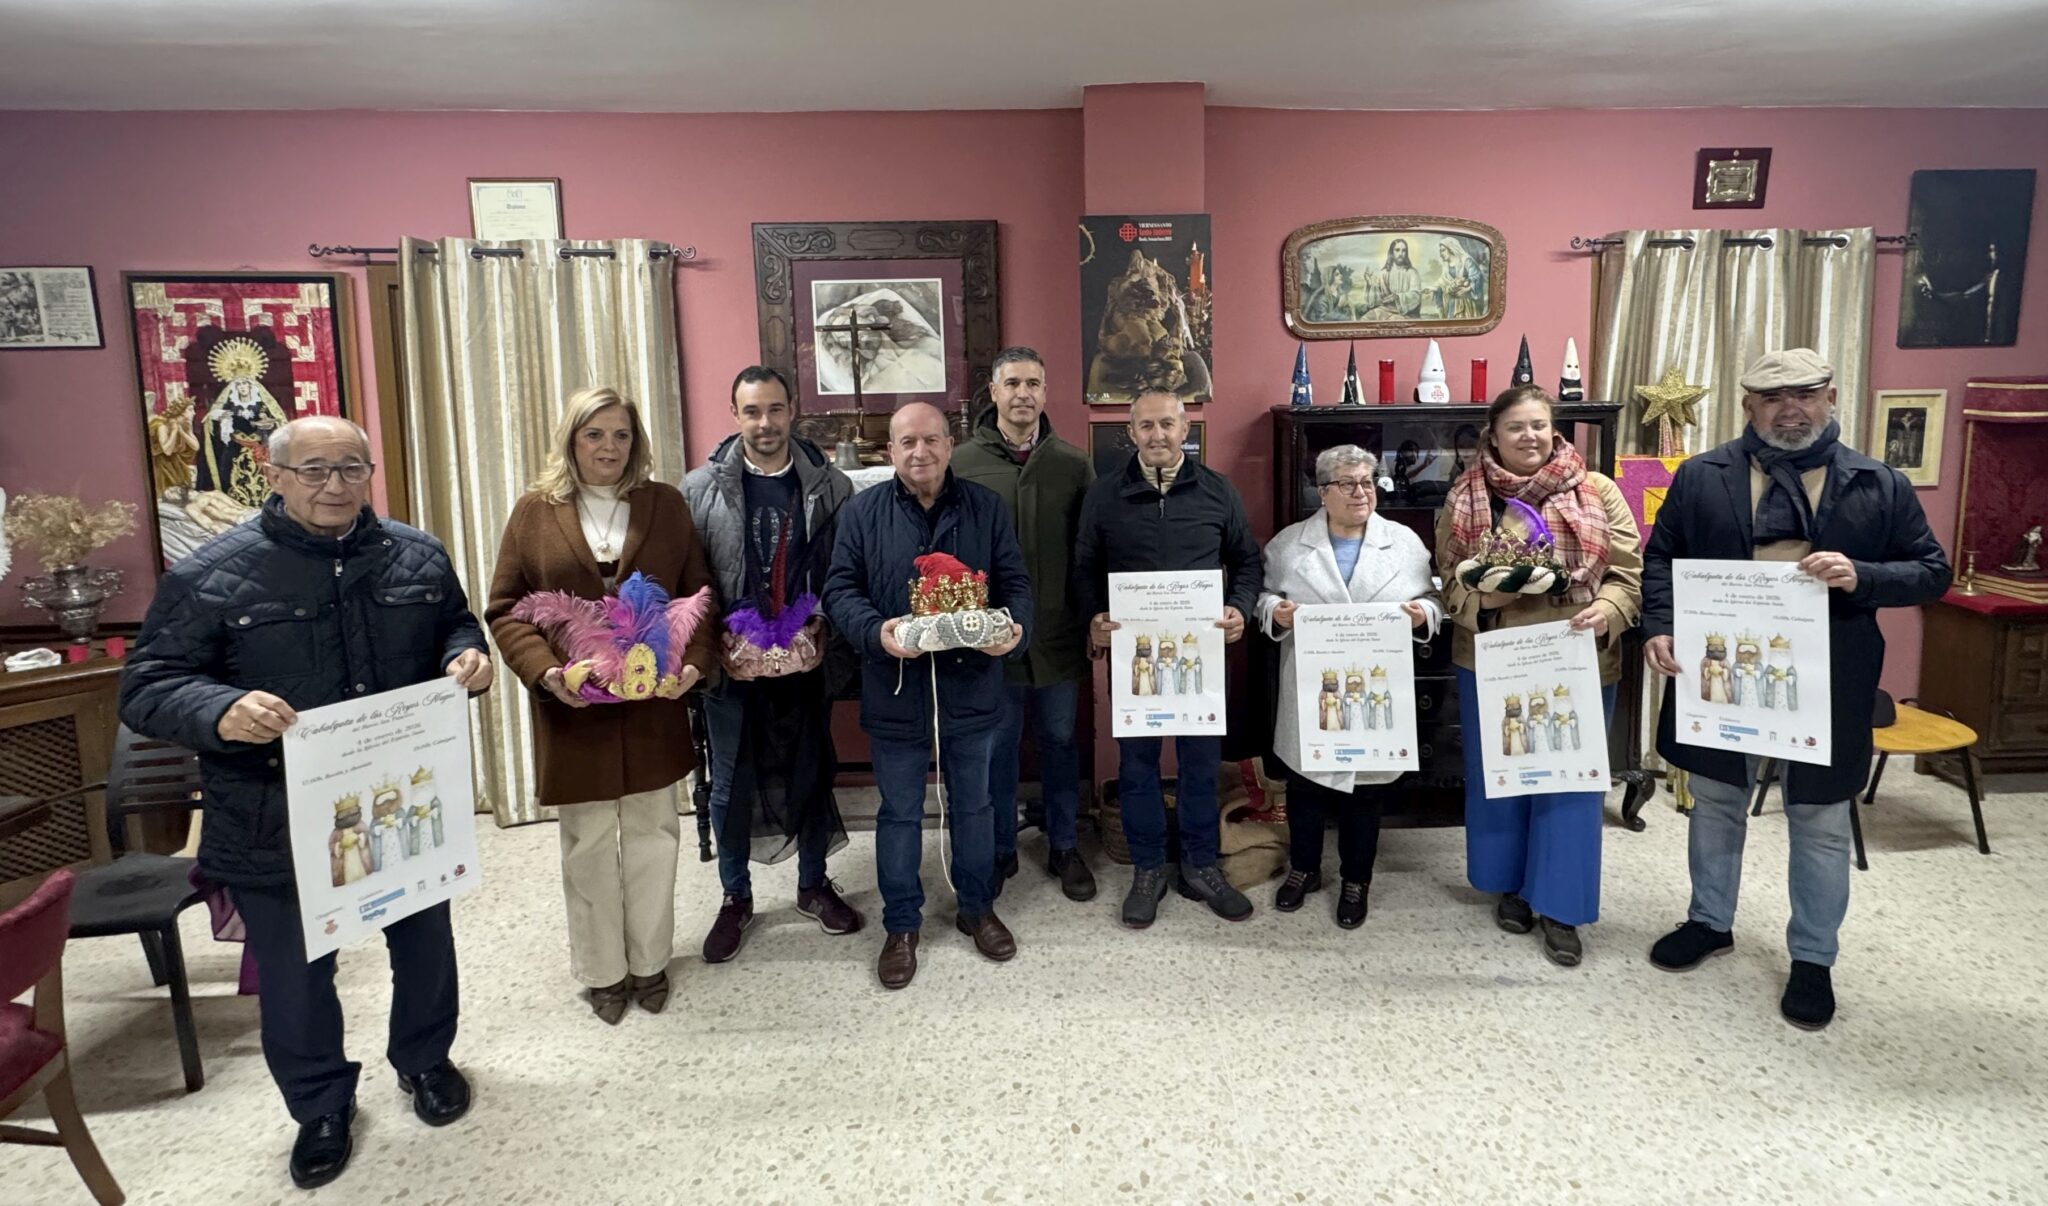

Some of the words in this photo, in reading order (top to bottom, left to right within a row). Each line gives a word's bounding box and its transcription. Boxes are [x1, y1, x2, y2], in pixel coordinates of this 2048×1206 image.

[1748, 572, 1779, 584] Reyes
[1167, 580, 1189, 592] Reyes
[298, 718, 354, 739] Cabalgata
[356, 712, 367, 724] de
[370, 710, 383, 720] los
[385, 701, 420, 718] Reyes
[422, 690, 456, 706] Magos
